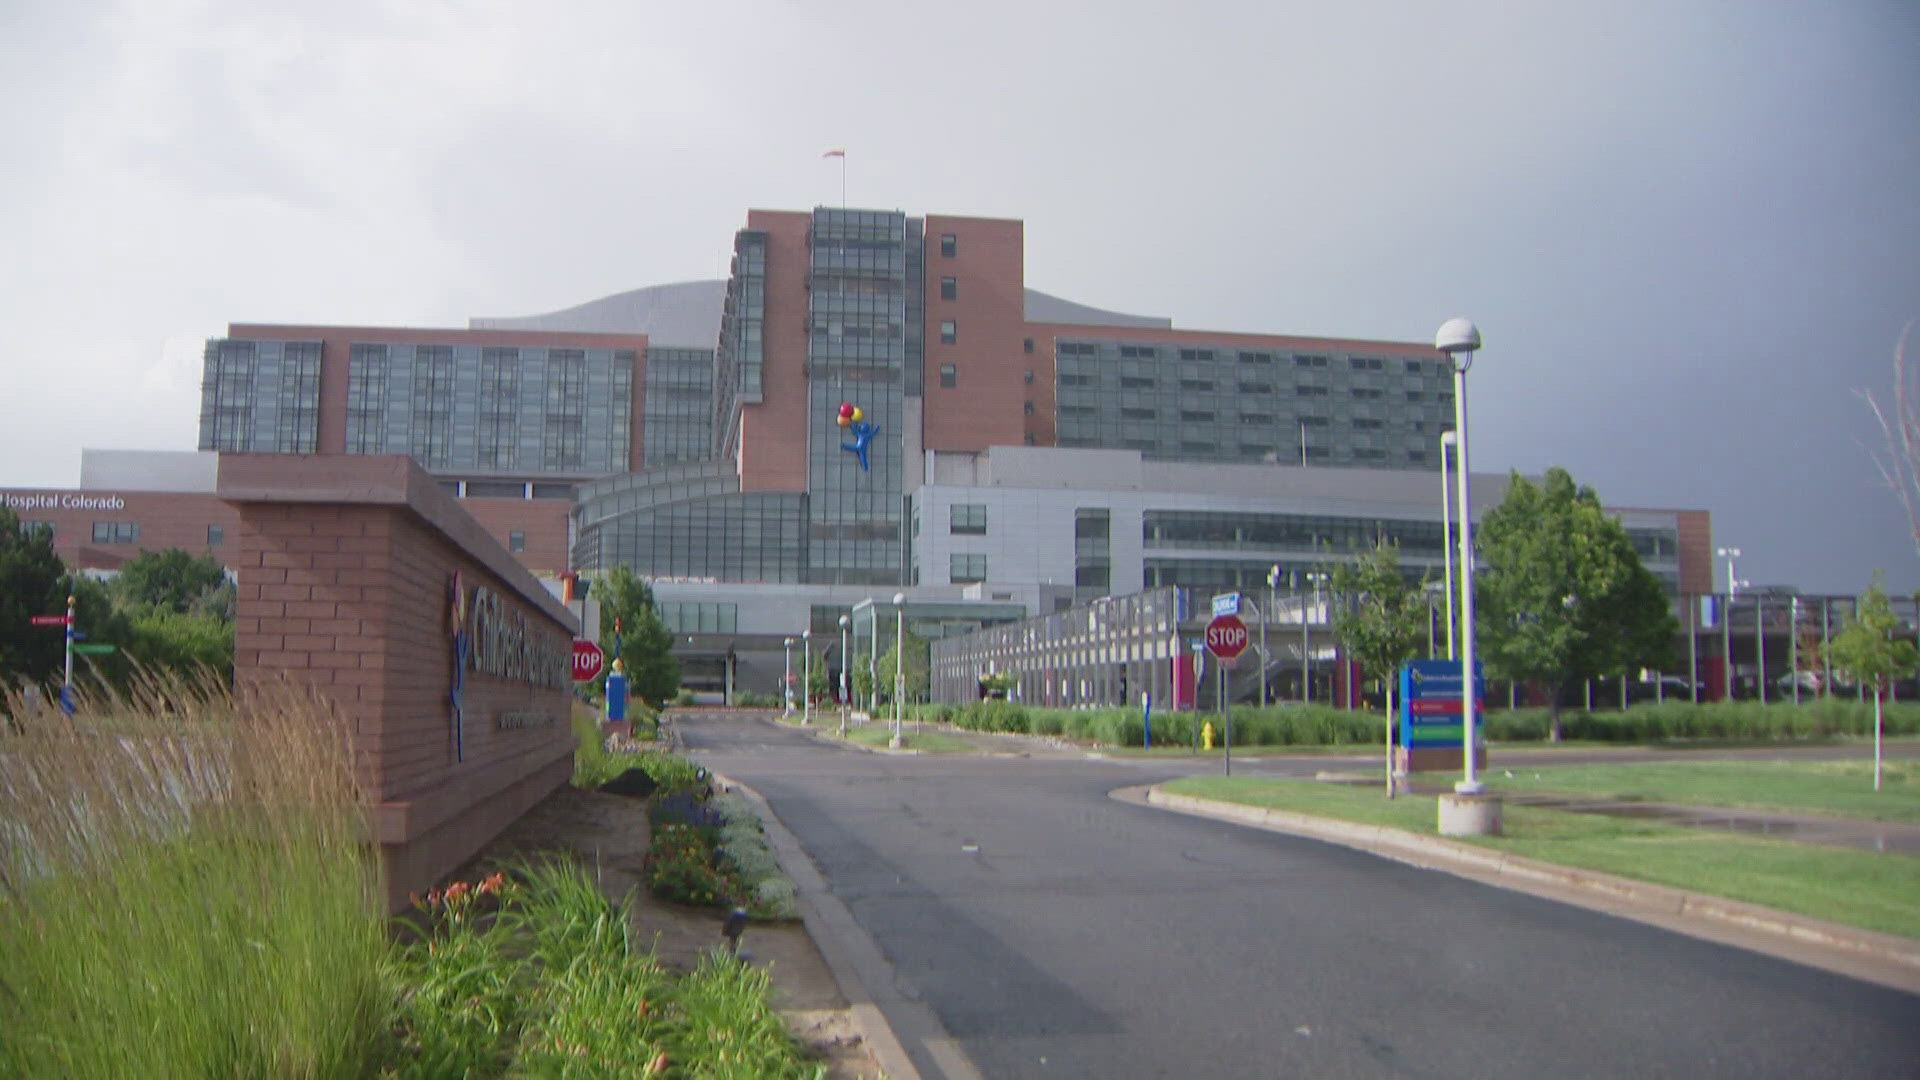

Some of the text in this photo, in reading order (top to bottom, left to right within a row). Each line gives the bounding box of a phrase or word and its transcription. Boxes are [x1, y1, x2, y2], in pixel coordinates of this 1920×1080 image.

[0, 493, 125, 511] Hospital Colorado
[1208, 627, 1245, 647] STOP
[573, 652, 600, 670] TOP
